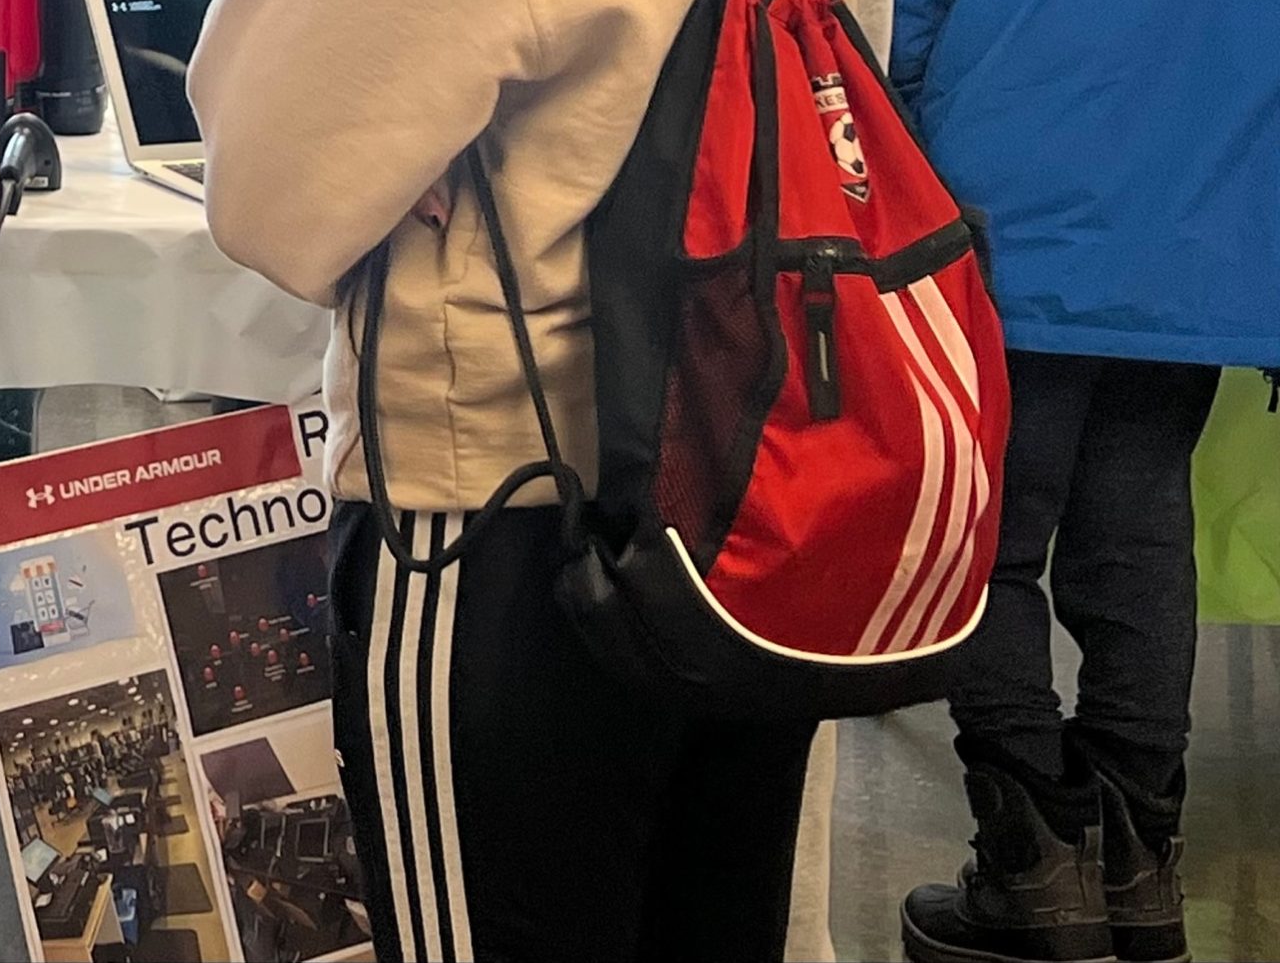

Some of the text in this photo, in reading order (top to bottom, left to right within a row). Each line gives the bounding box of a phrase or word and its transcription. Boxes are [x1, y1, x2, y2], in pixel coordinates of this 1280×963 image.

[58, 448, 223, 500] UNDER ARMOUR
[124, 486, 327, 566] Techno
